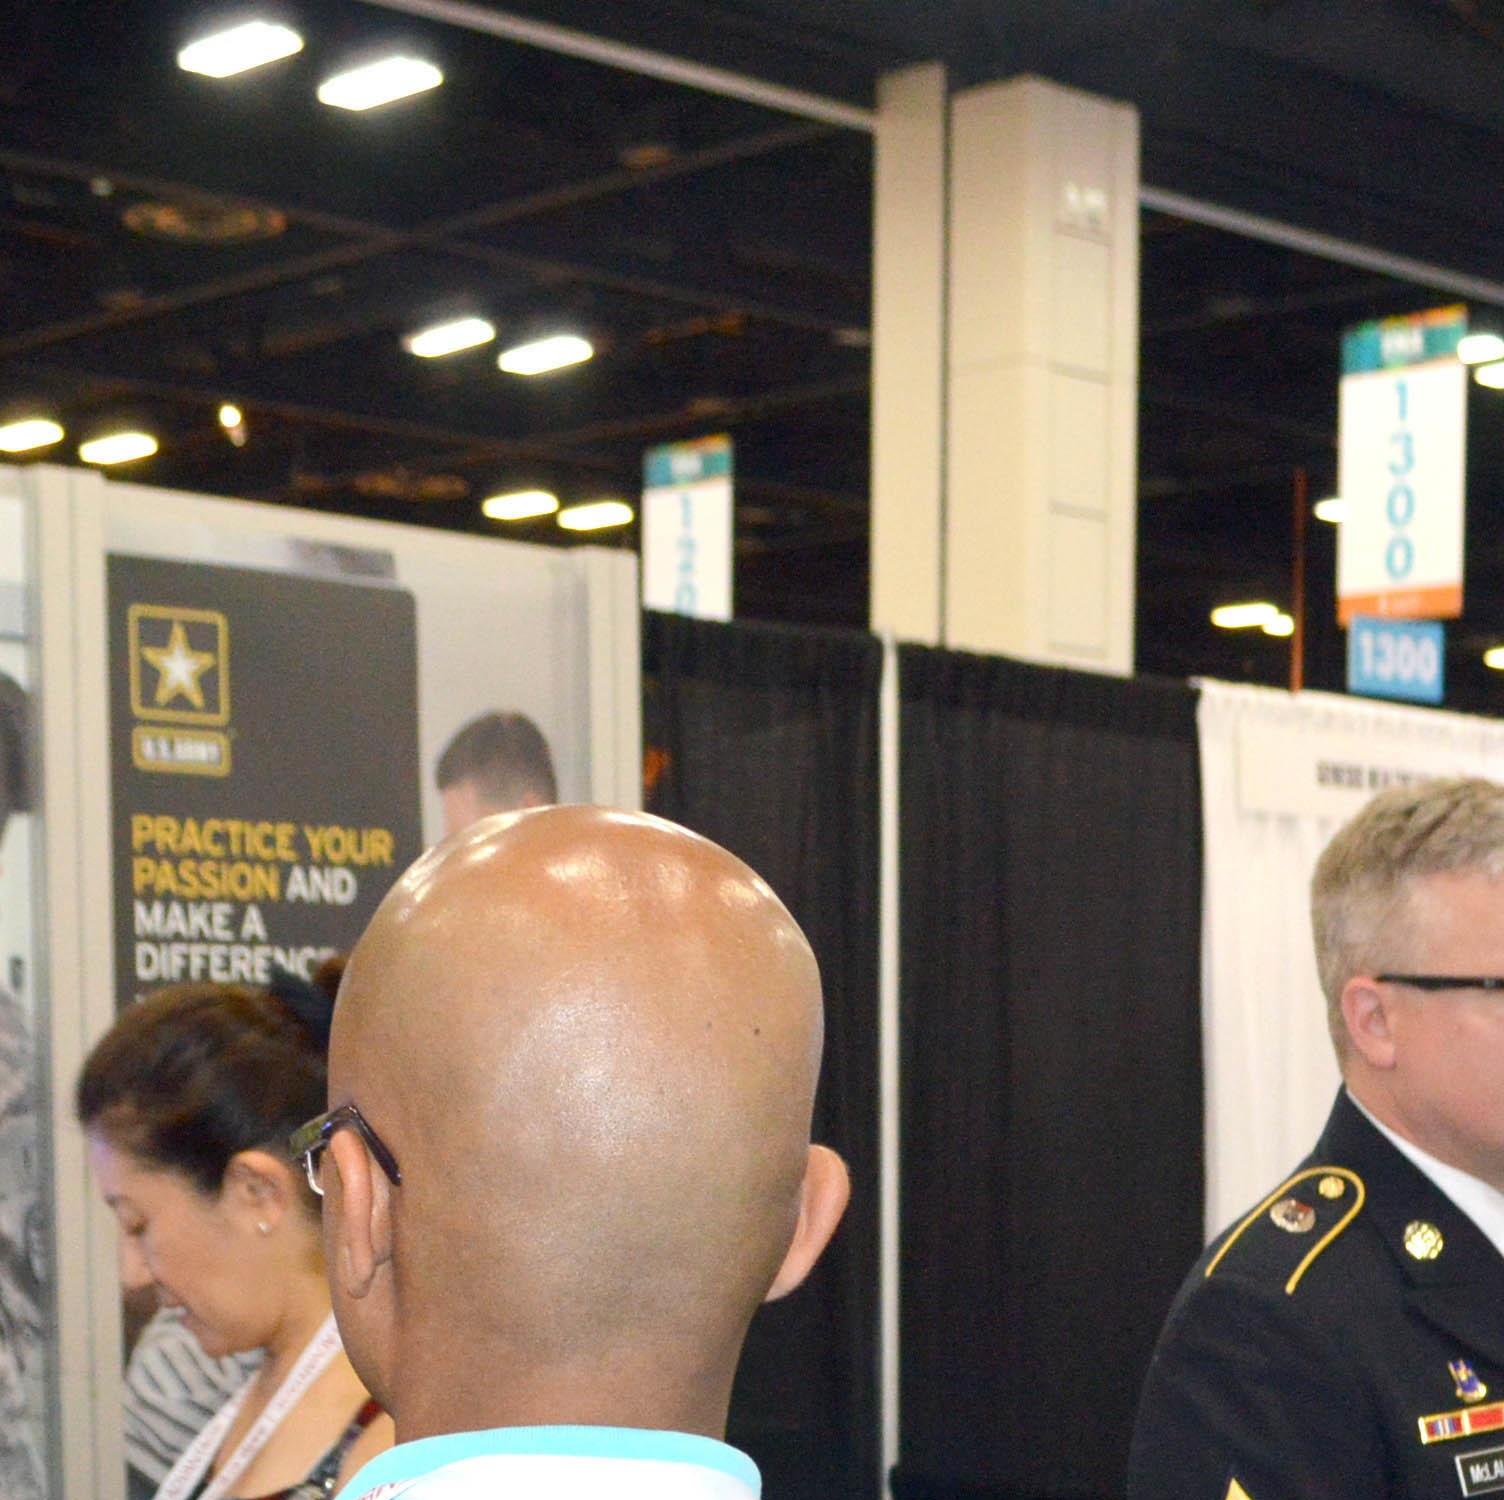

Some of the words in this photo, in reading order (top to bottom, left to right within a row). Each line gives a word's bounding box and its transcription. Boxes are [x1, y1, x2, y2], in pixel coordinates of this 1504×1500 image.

[1386, 380, 1415, 579] 1300
[1358, 630, 1439, 686] 1300
[133, 814, 297, 860] PRACTICE
[307, 826, 393, 864] YOUR
[134, 858, 279, 899] PASSION
[287, 867, 356, 904] AND
[135, 902, 232, 940] MAKE
[242, 905, 267, 940] A
[135, 941, 336, 985] DIFFERENC
